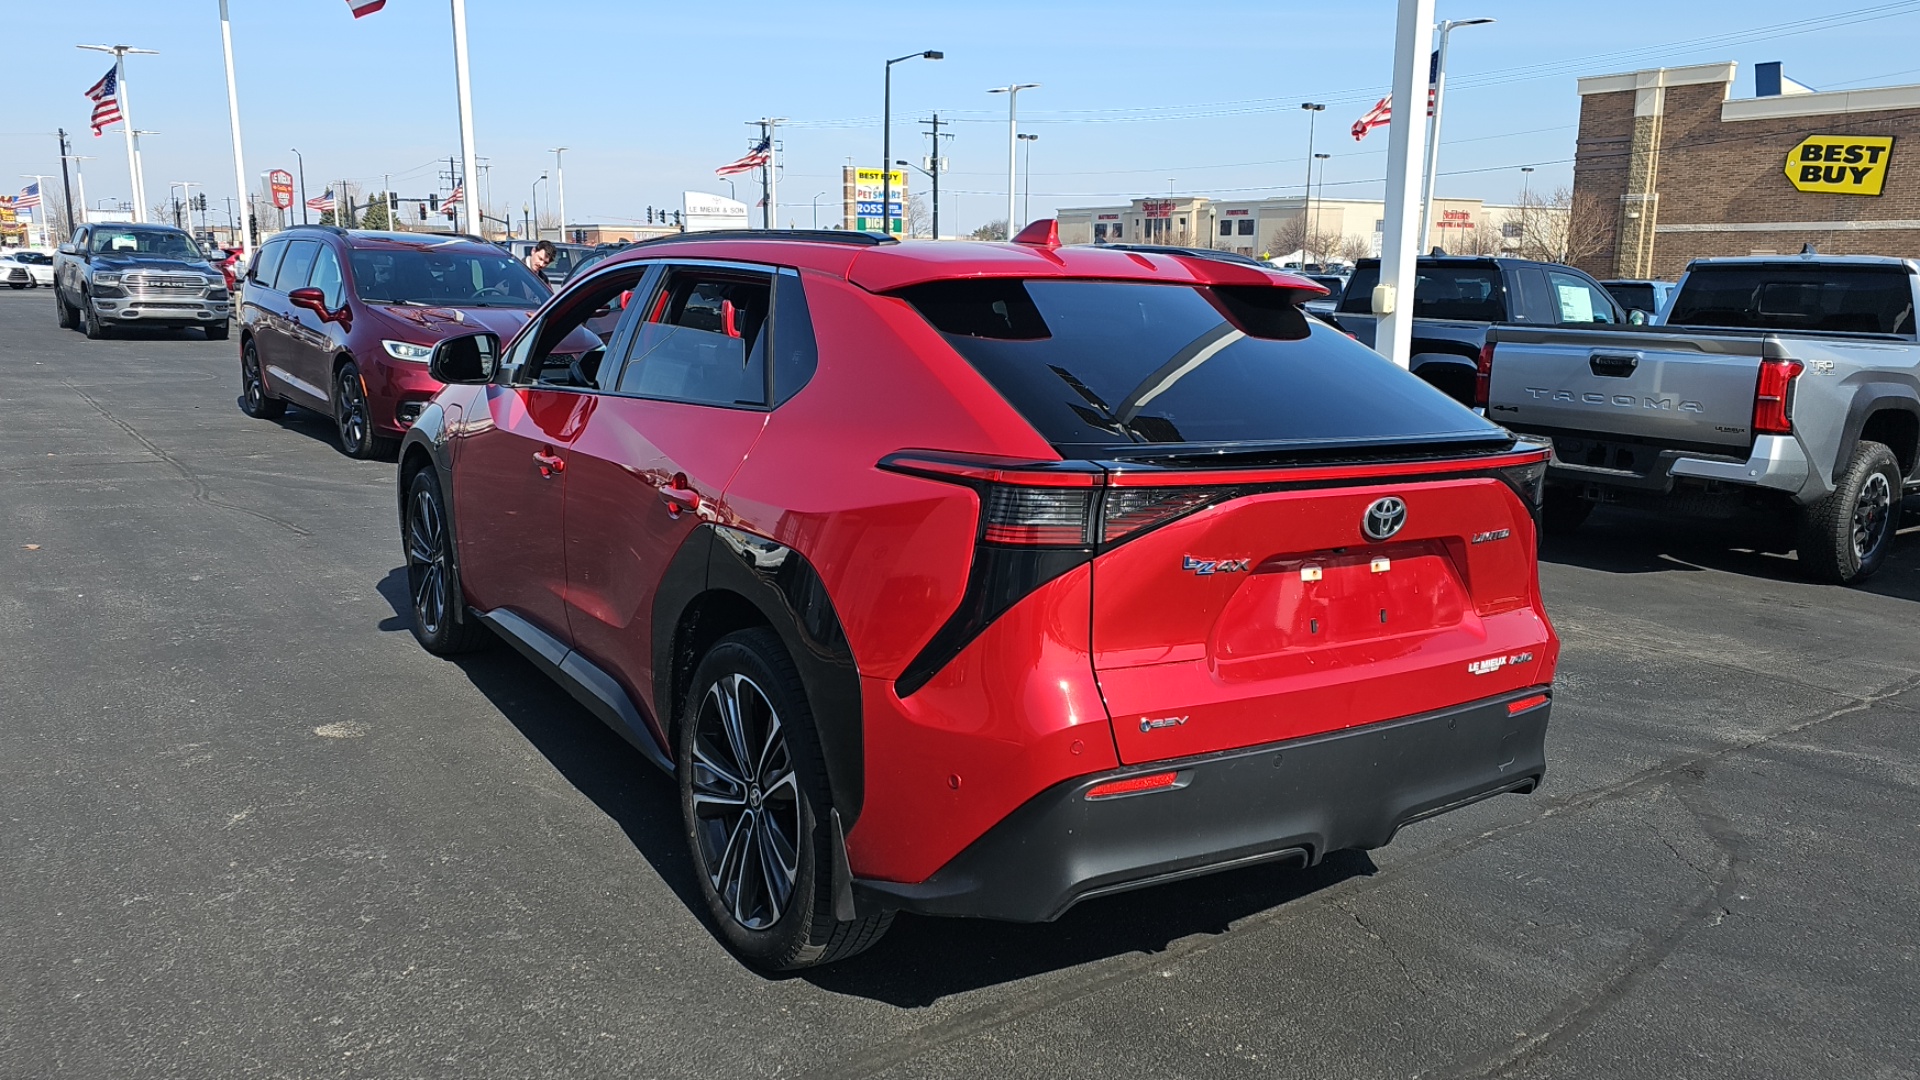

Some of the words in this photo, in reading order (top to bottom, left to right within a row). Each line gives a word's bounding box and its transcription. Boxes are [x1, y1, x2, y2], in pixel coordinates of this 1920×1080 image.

[1800, 144, 1886, 164] BEST
[859, 172, 879, 180] BEST
[1799, 165, 1875, 185] BUY
[858, 189, 902, 199] PETSMRT
[857, 203, 883, 214] ROSS
[1809, 359, 1835, 370] TRD
[1525, 387, 1704, 413] TACOMA
[1468, 661, 1479, 673] LE
[1480, 655, 1507, 669] MIEUX
